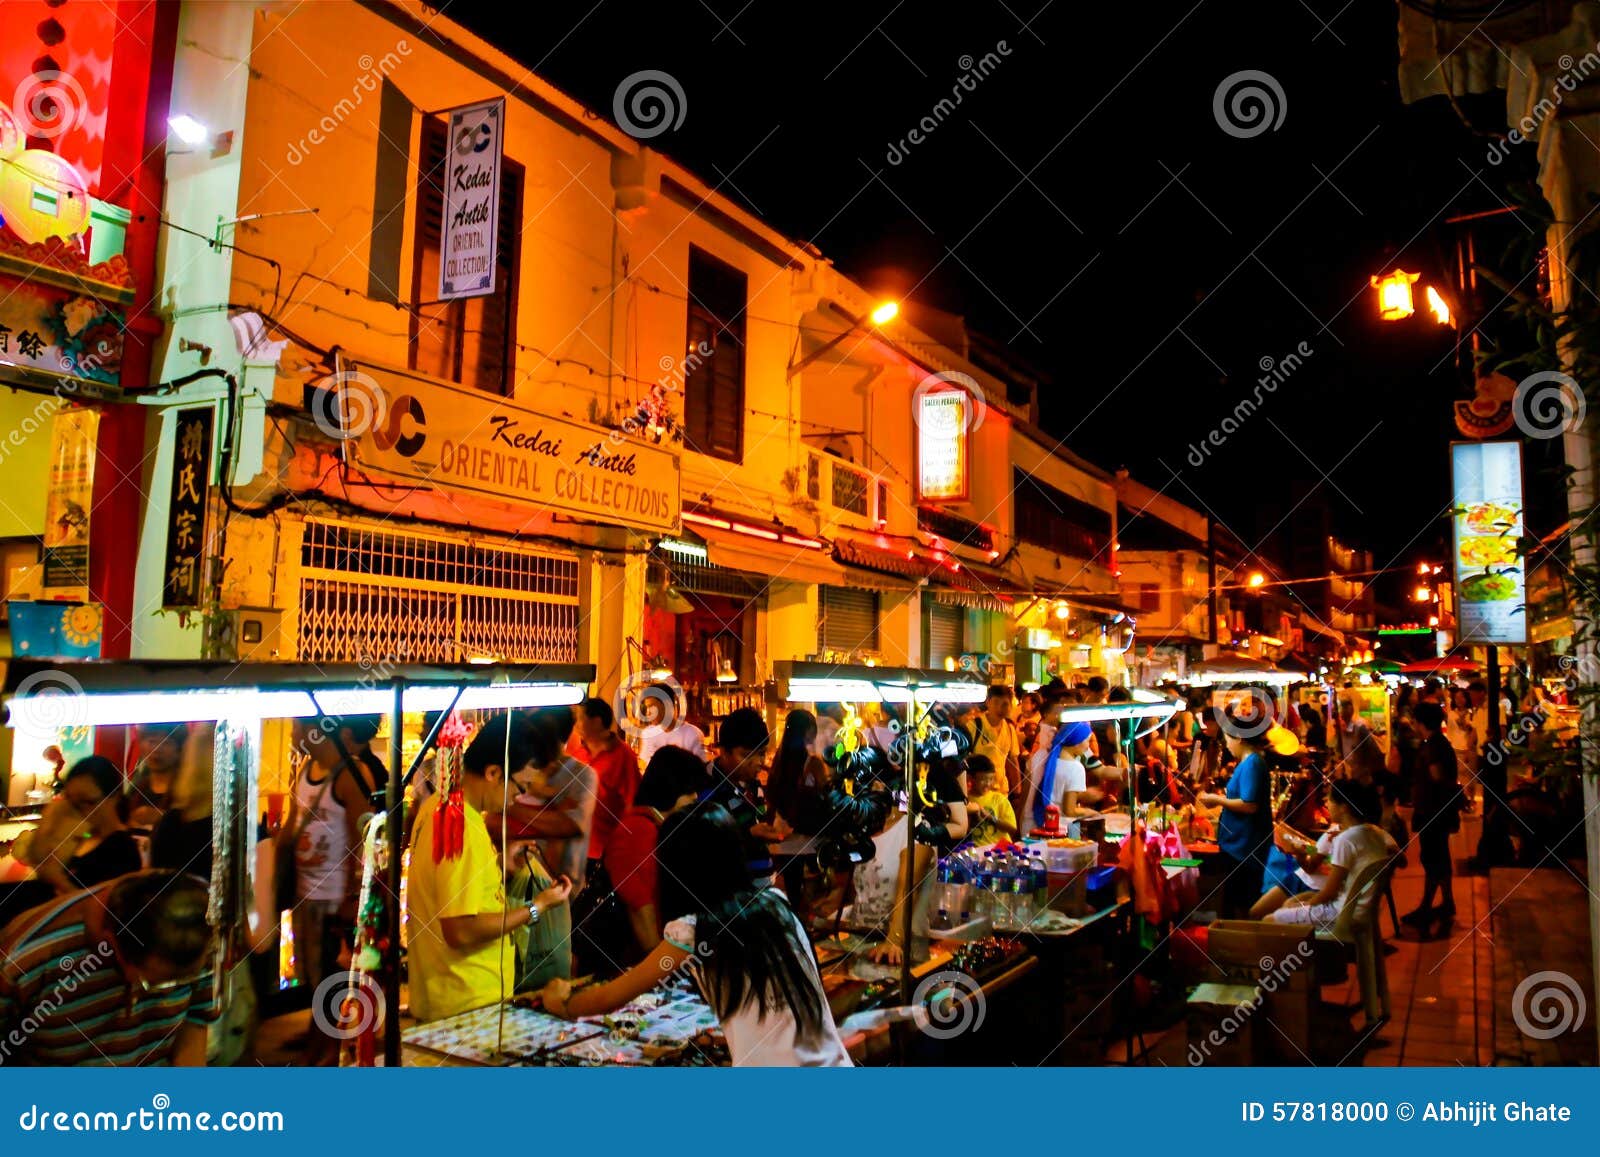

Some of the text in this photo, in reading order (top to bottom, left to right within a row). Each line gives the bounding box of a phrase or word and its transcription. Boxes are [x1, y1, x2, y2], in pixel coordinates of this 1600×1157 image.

[453, 164, 492, 192] Kedai
[452, 196, 489, 229] Antik
[453, 231, 484, 252] ORIENTAL
[490, 416, 637, 476] Kedai Antik
[440, 439, 669, 519] ORIENTAL COLLECTIONS
